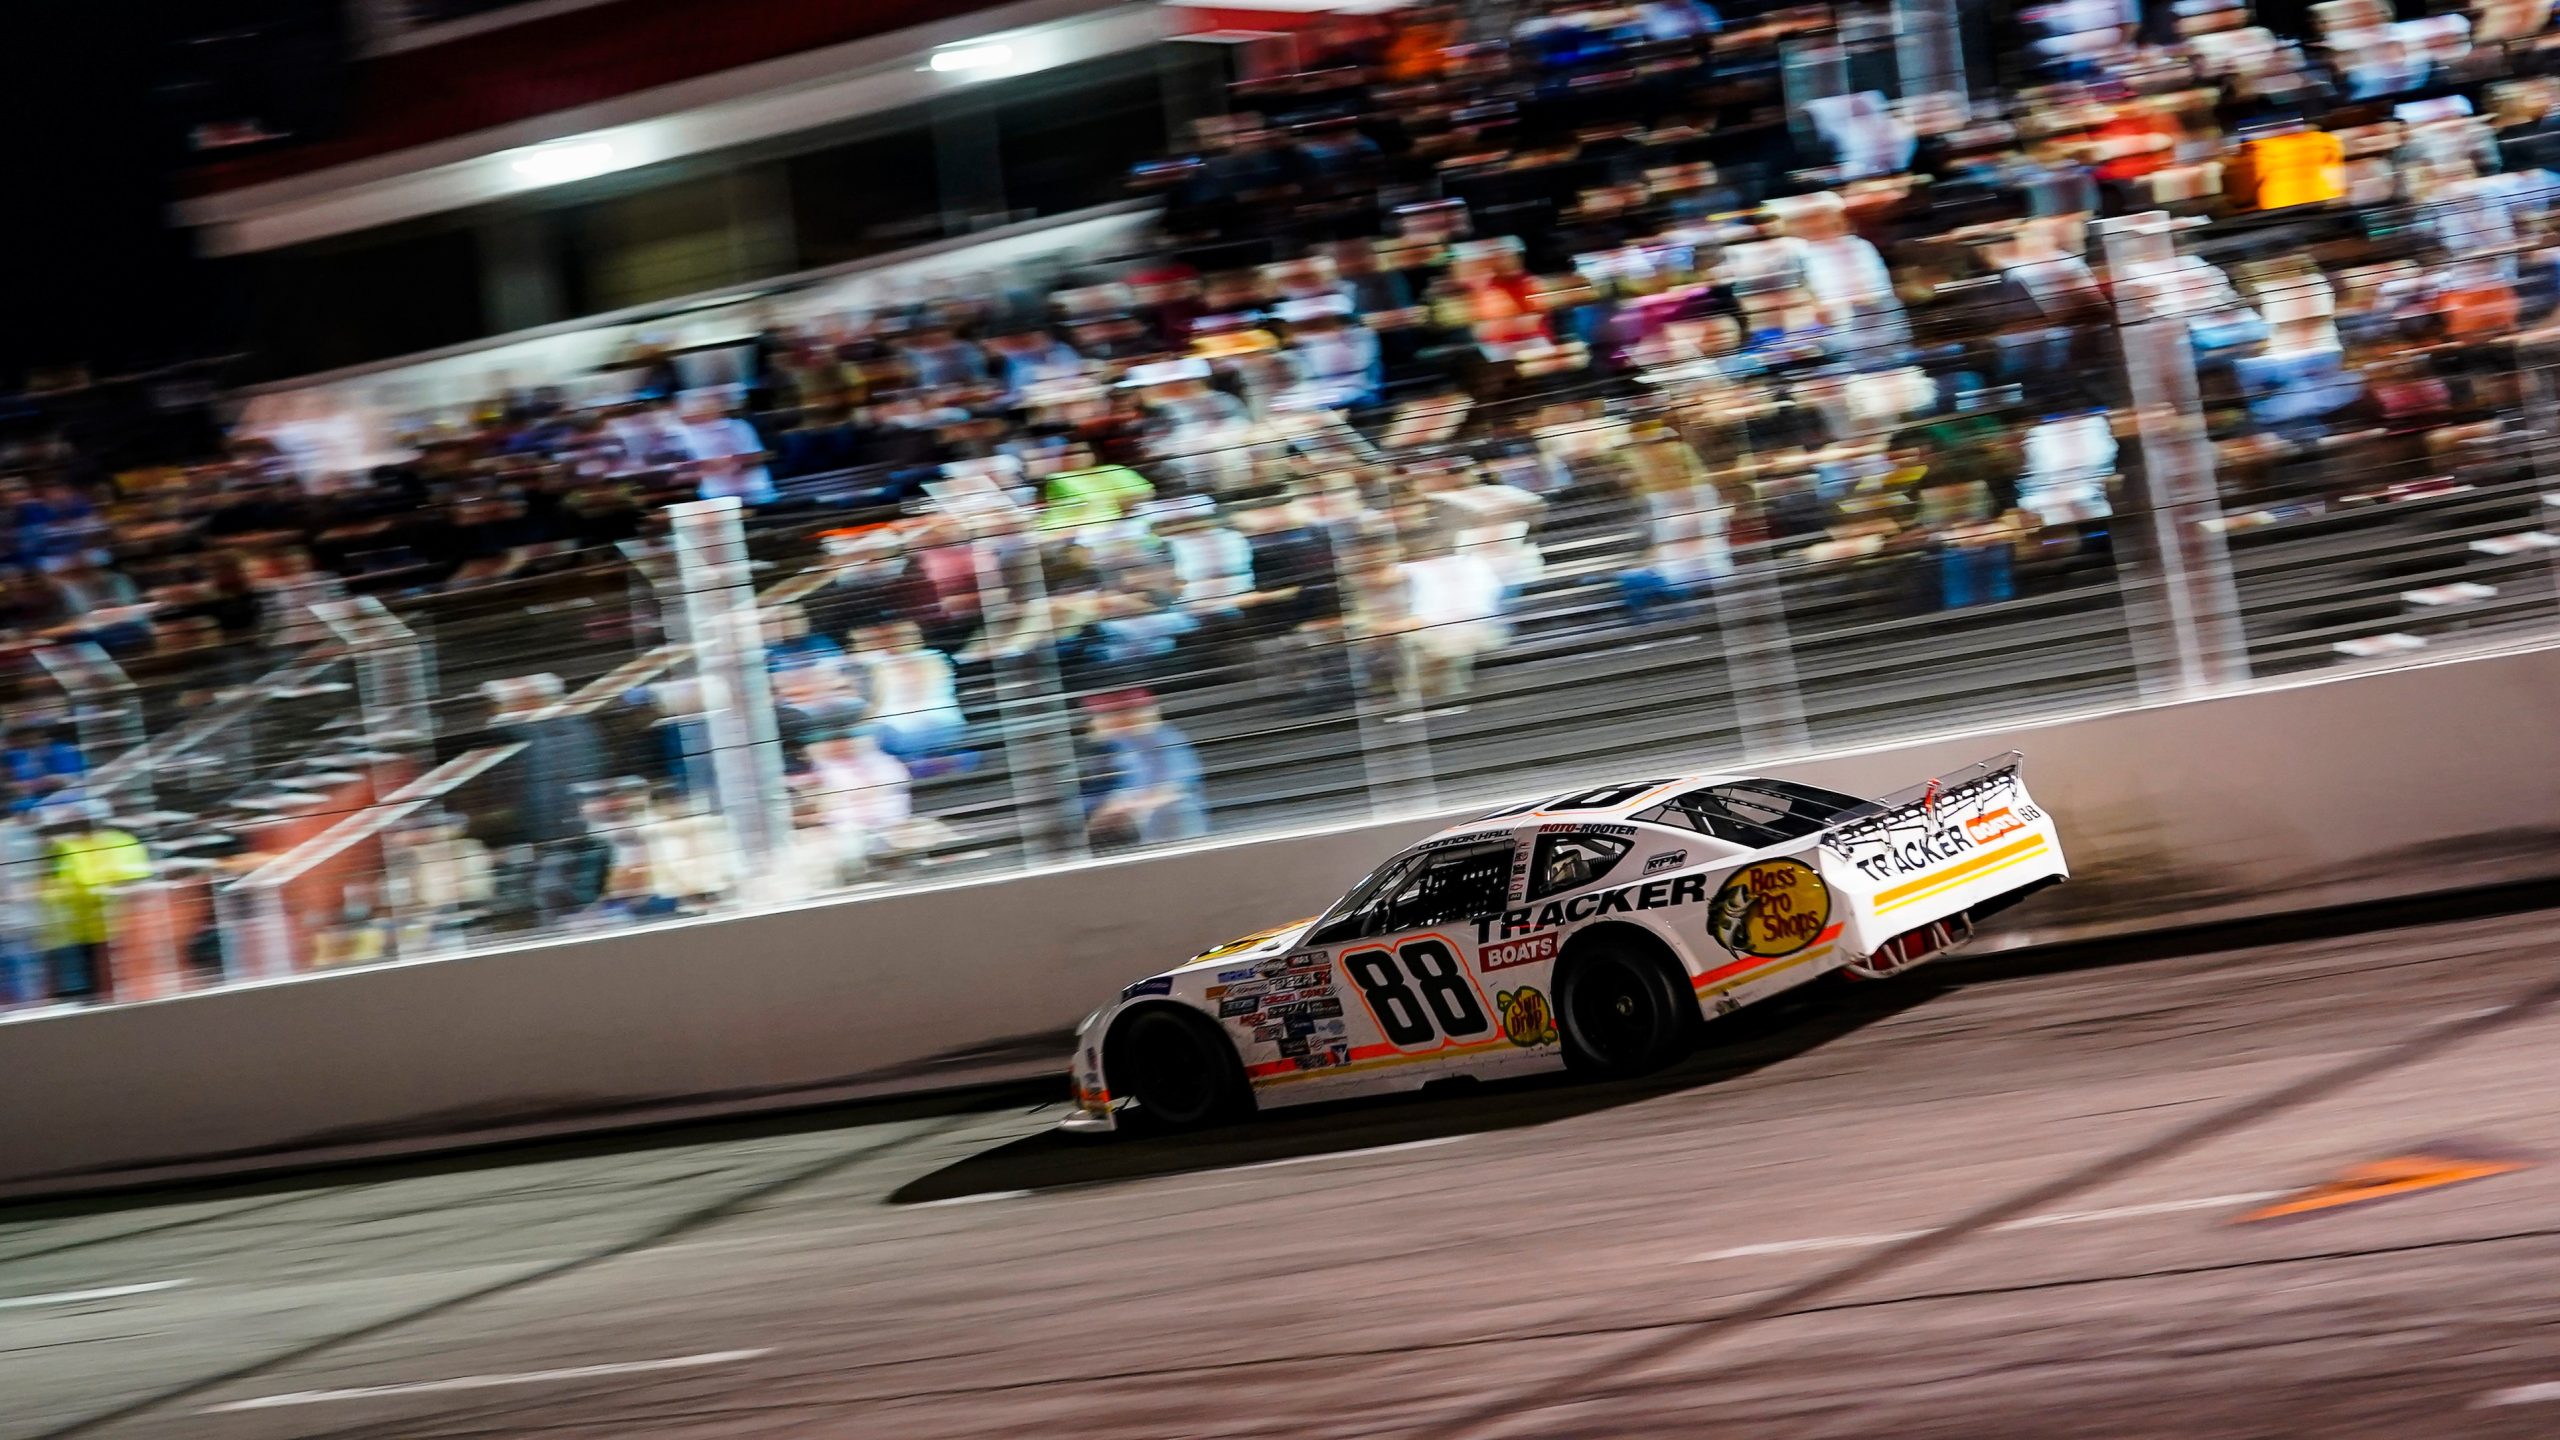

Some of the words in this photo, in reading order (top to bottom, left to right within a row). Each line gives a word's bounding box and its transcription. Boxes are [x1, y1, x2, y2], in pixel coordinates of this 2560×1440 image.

[1418, 833, 1478, 851] CONNOR
[1477, 829, 1512, 841] HALL
[1538, 823, 1638, 836] ROTO-ROOTER
[1647, 852, 1686, 871] RPM
[1856, 825, 1974, 881] TRACKER
[1749, 867, 1797, 895] Bass
[1470, 873, 1704, 945] TRACKER
[1757, 892, 1792, 919] Pro
[1762, 910, 1820, 943] Shops
[1488, 938, 1552, 968] BOATS
[1345, 939, 1489, 1046] 88
